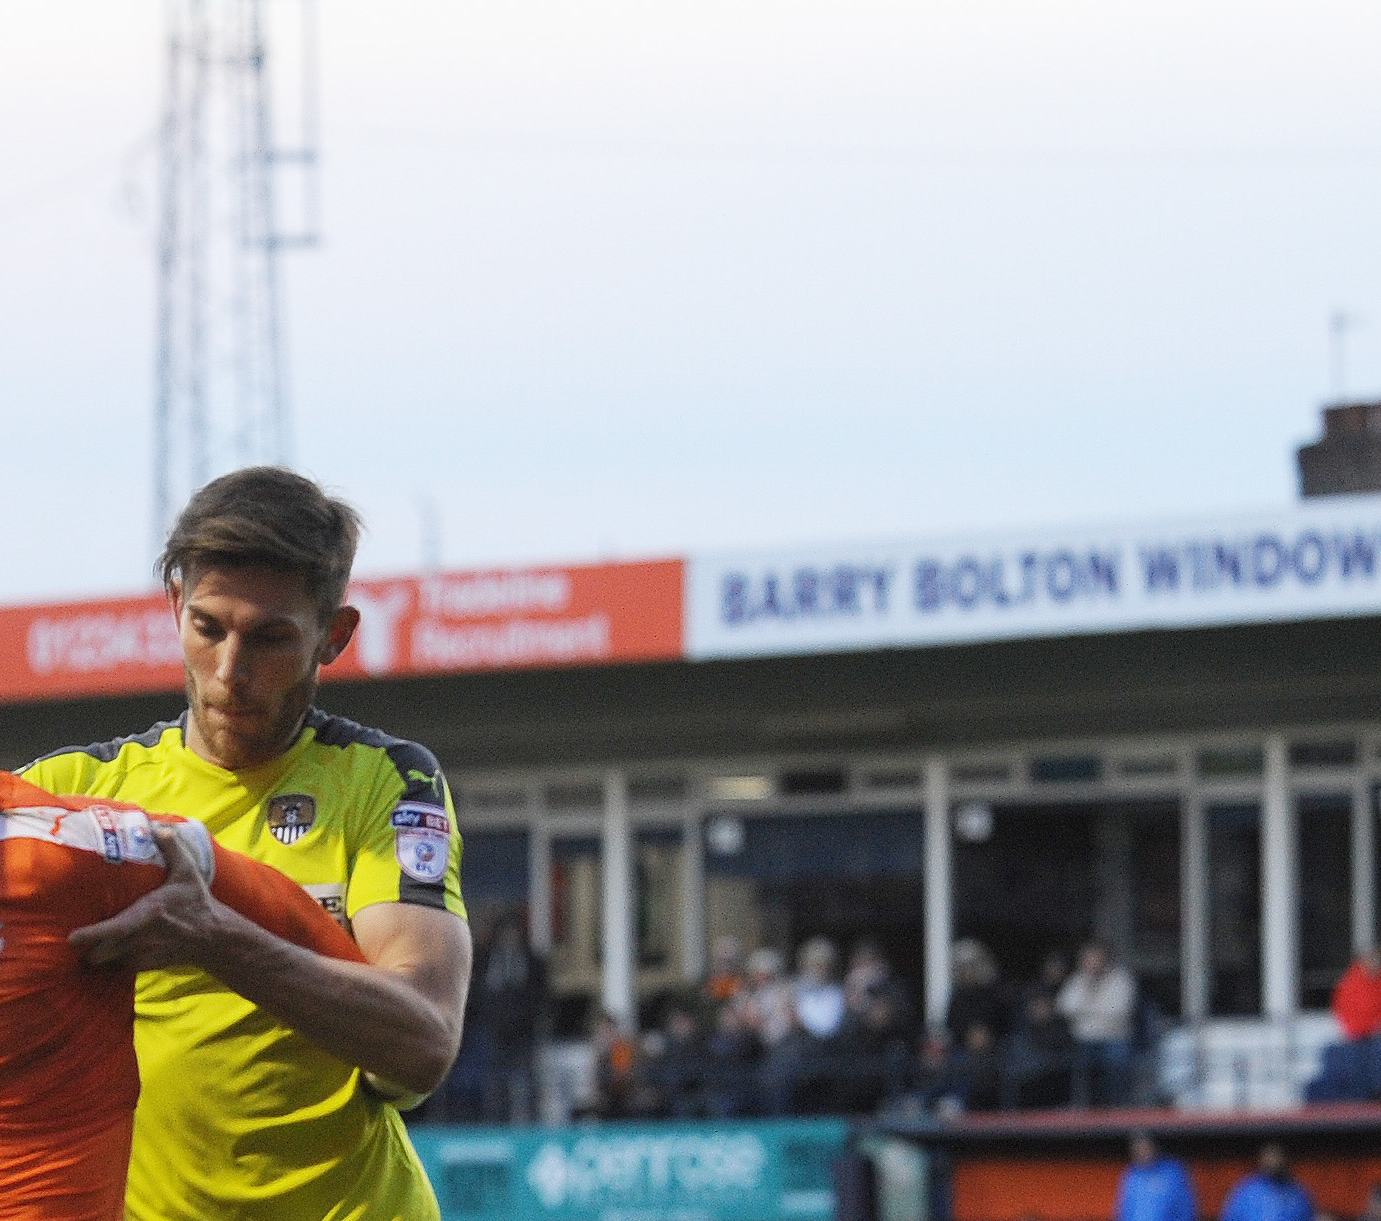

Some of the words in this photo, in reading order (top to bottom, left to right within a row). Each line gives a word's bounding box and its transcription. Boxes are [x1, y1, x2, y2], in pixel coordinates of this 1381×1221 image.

[721, 563, 892, 626] BARRY
[914, 546, 1119, 613] BOLTON
[415, 616, 607, 666] Recruitment
